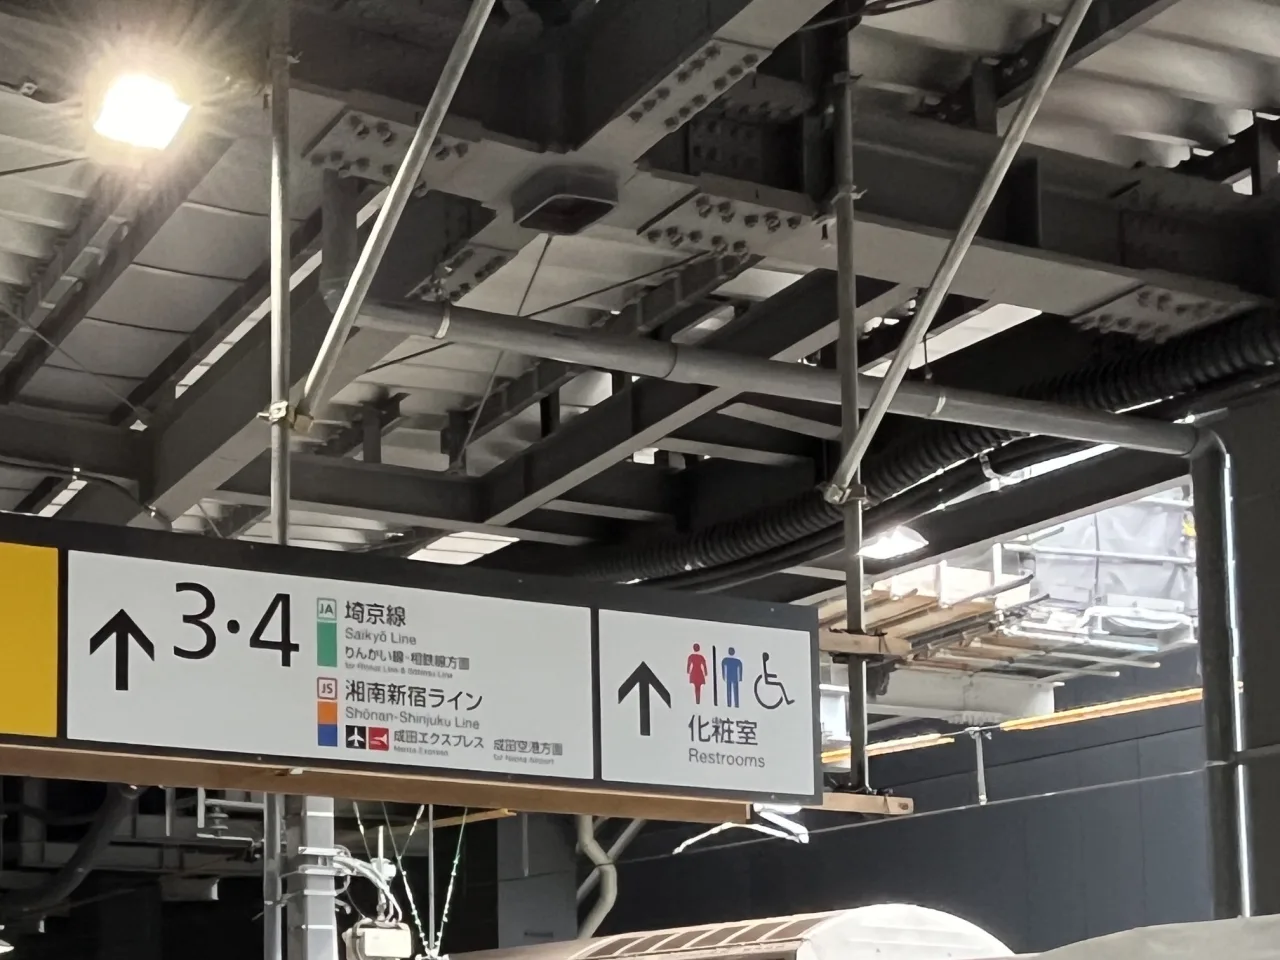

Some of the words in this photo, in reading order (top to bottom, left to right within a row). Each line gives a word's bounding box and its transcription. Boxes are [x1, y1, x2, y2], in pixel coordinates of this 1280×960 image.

[320, 604, 334, 615] JA
[344, 600, 407, 627] 埼京線
[390, 632, 417, 645] Line
[321, 683, 333, 694] JS
[345, 679, 483, 711] 湘南新宿ライン
[455, 718, 480, 730] Line
[688, 715, 759, 746] 化粧室
[688, 748, 765, 768] Restrooms
